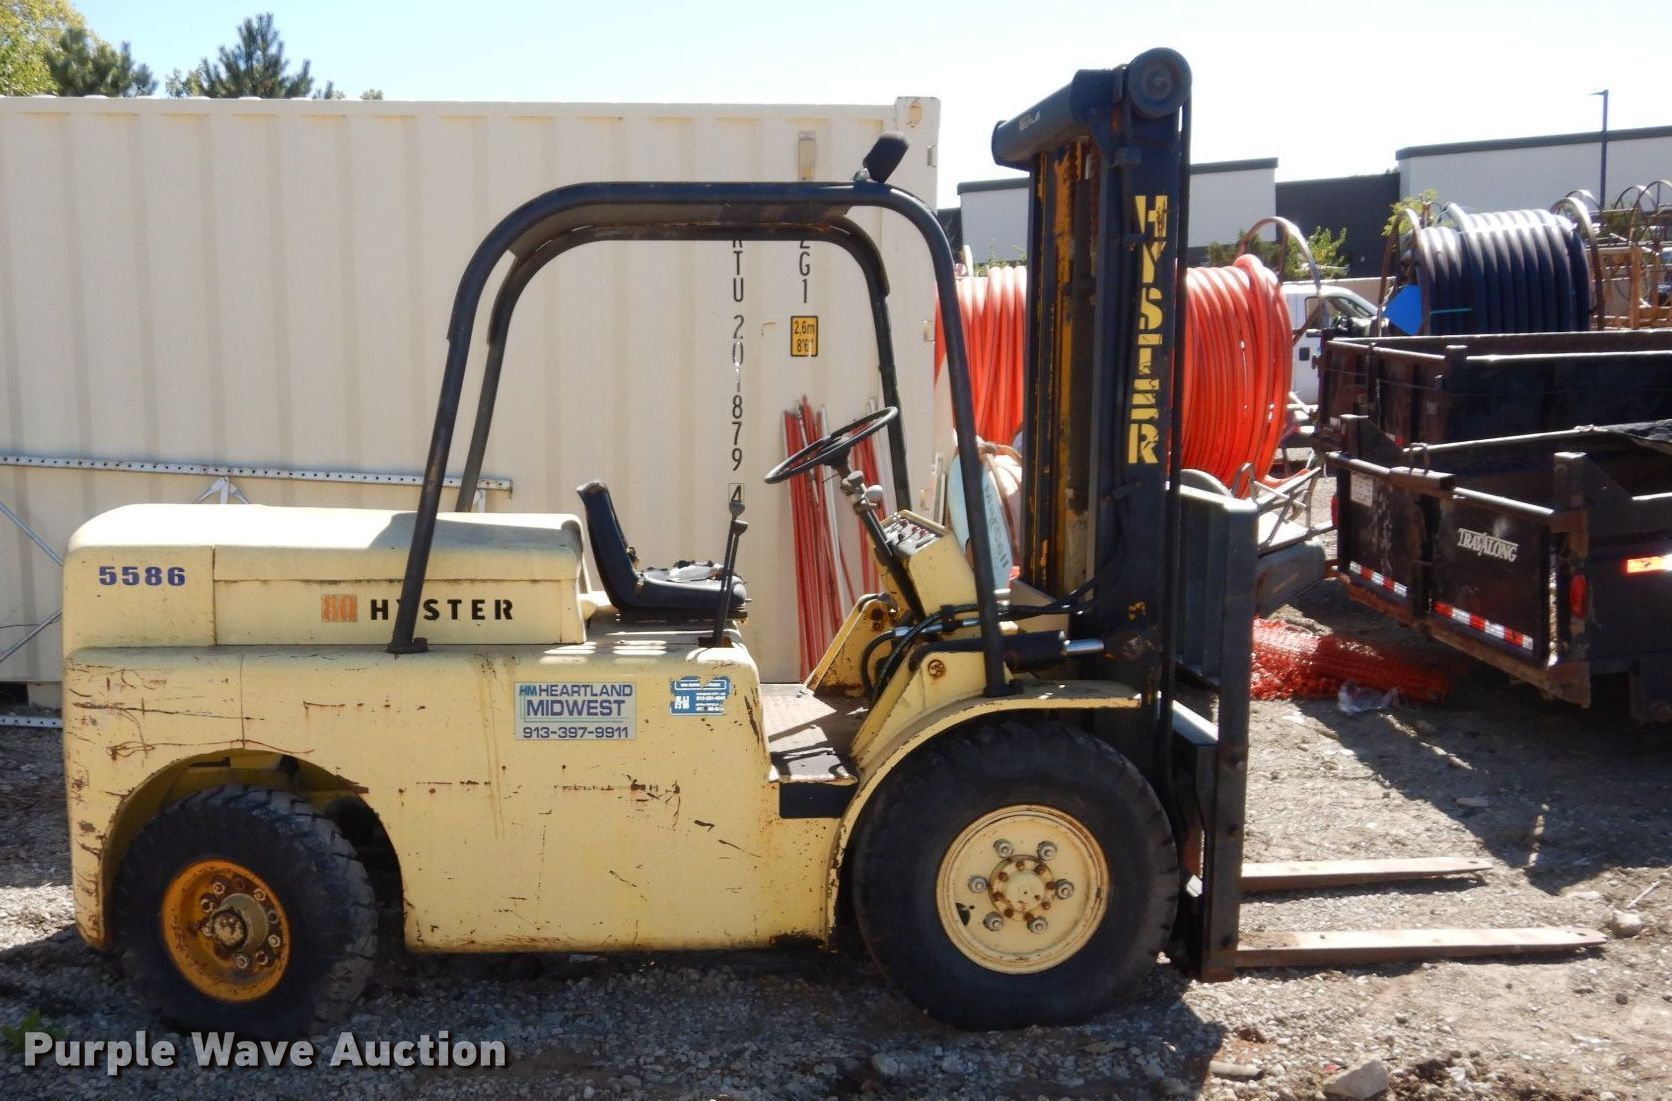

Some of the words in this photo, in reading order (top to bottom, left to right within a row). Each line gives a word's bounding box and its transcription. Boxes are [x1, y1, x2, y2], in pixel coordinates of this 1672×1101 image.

[1127, 194, 1168, 465] HYSTER
[98, 565, 186, 587] 5586
[370, 598, 514, 621] HSTER
[538, 684, 634, 698] HEARTLAND
[526, 699, 626, 717] MIDWEST
[522, 726, 629, 739] 913-397-9911
